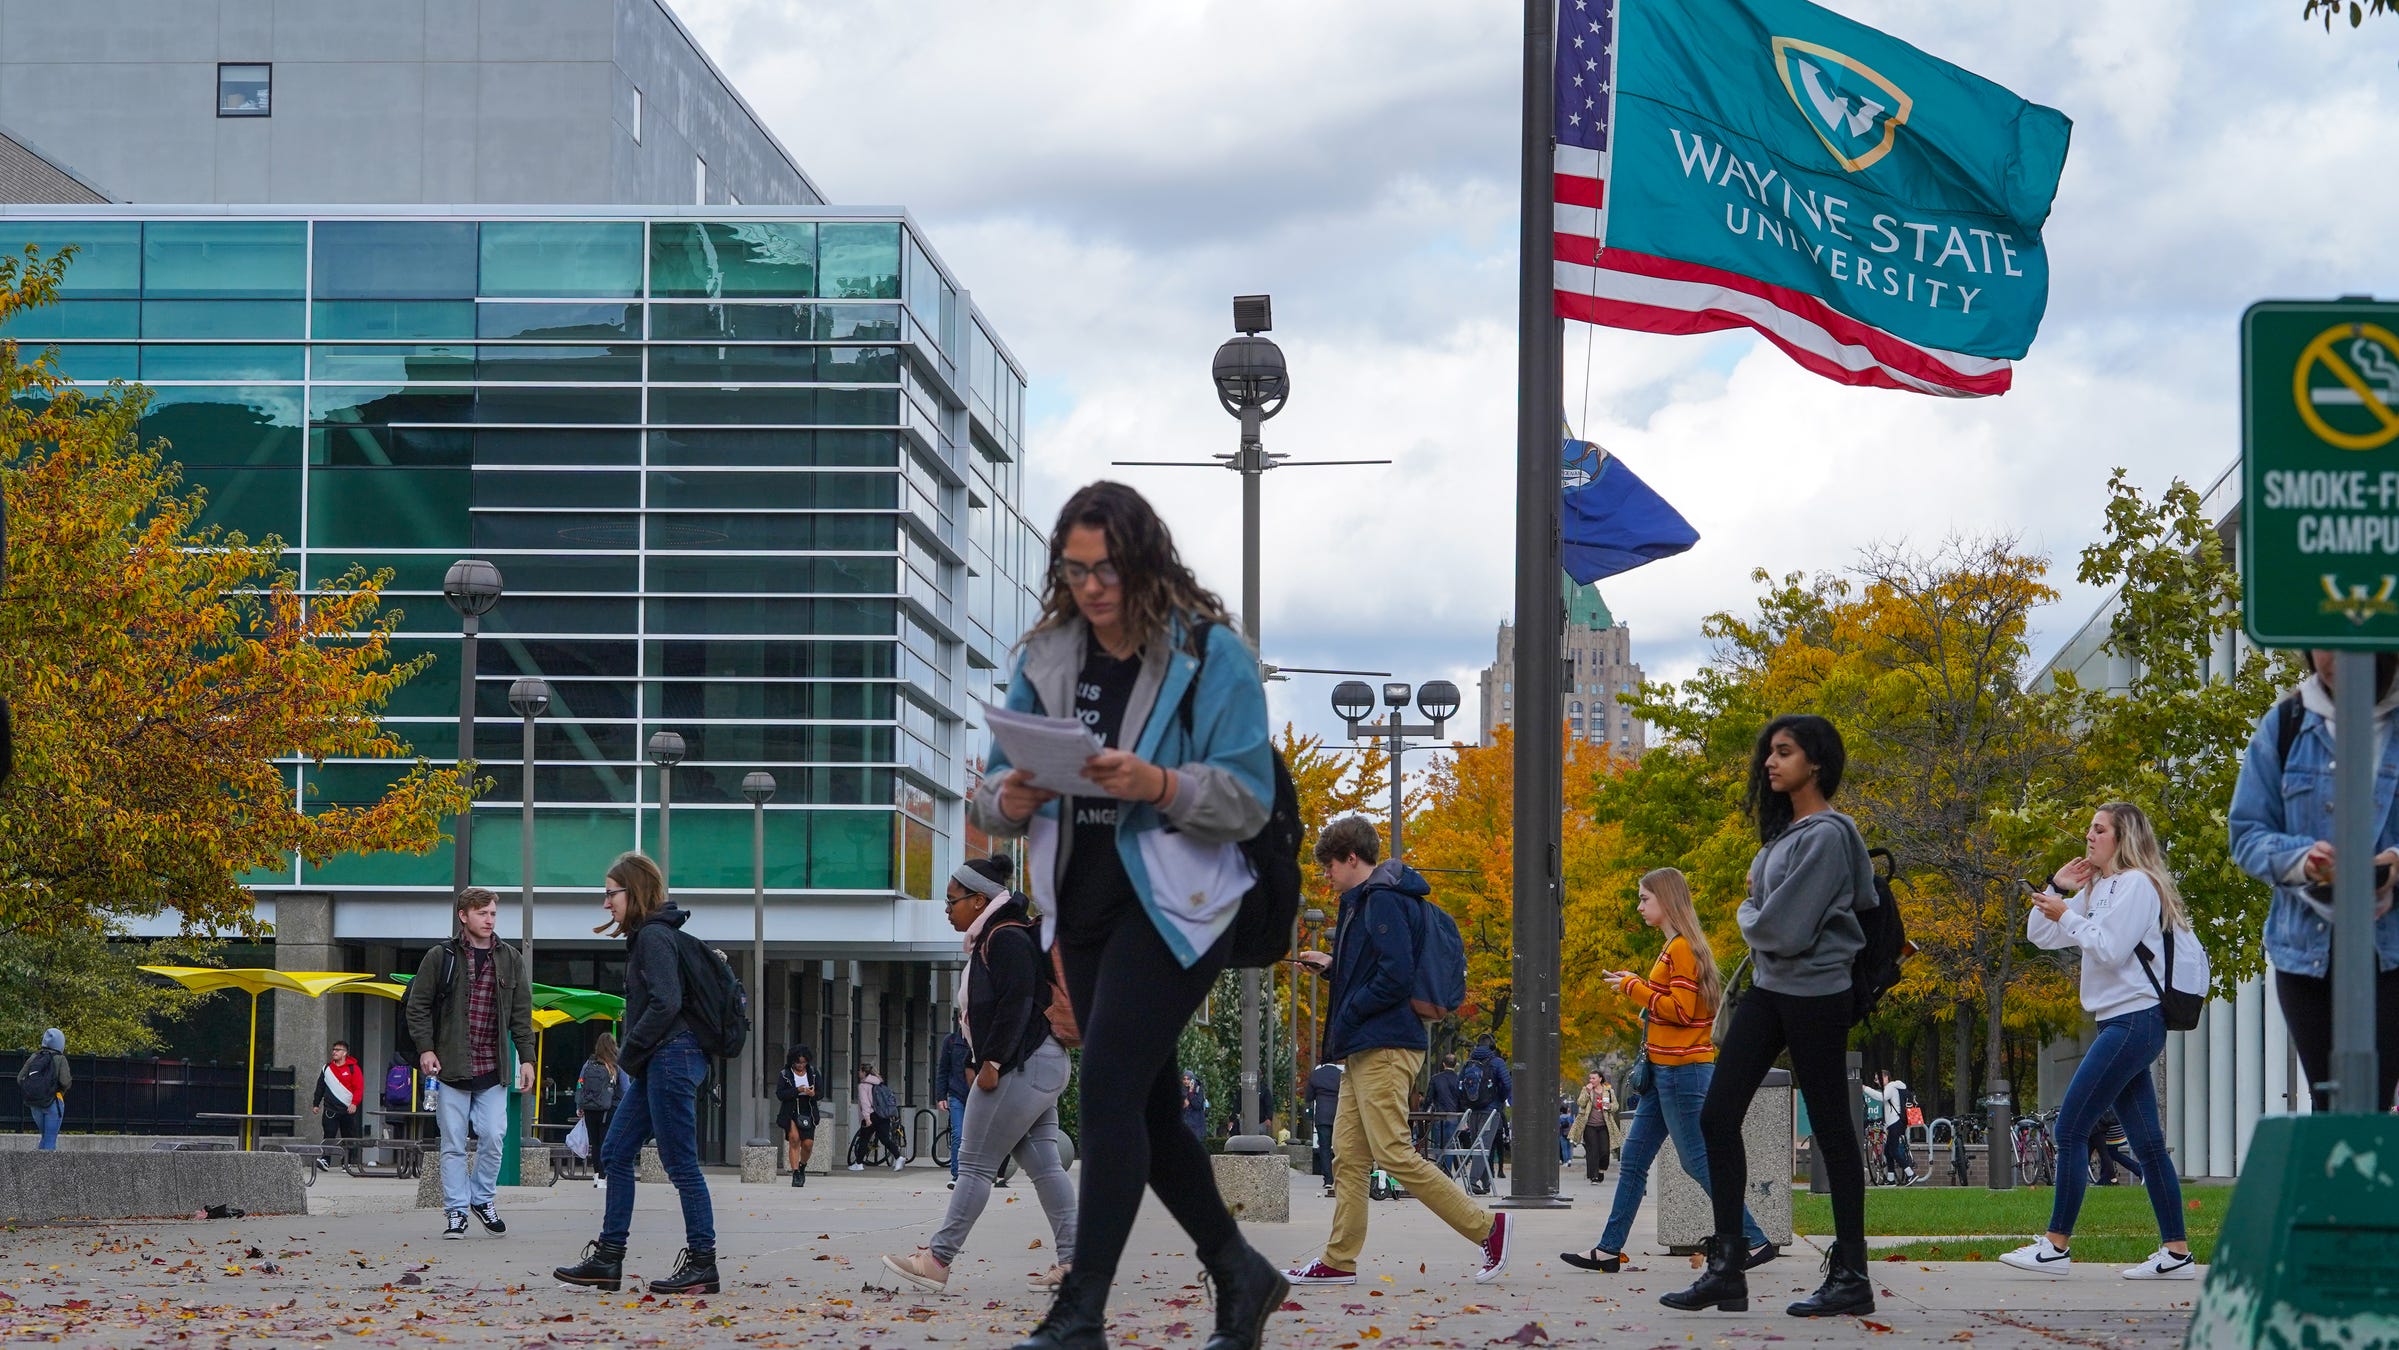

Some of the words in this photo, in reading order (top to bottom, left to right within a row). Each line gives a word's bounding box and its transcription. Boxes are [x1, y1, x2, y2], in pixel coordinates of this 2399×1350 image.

[1670, 127, 1853, 241] WAYNE
[1870, 212, 2024, 277] STATE
[1725, 202, 1983, 315] UNIVERSITY
[2263, 469, 2399, 510] SMOKE-F
